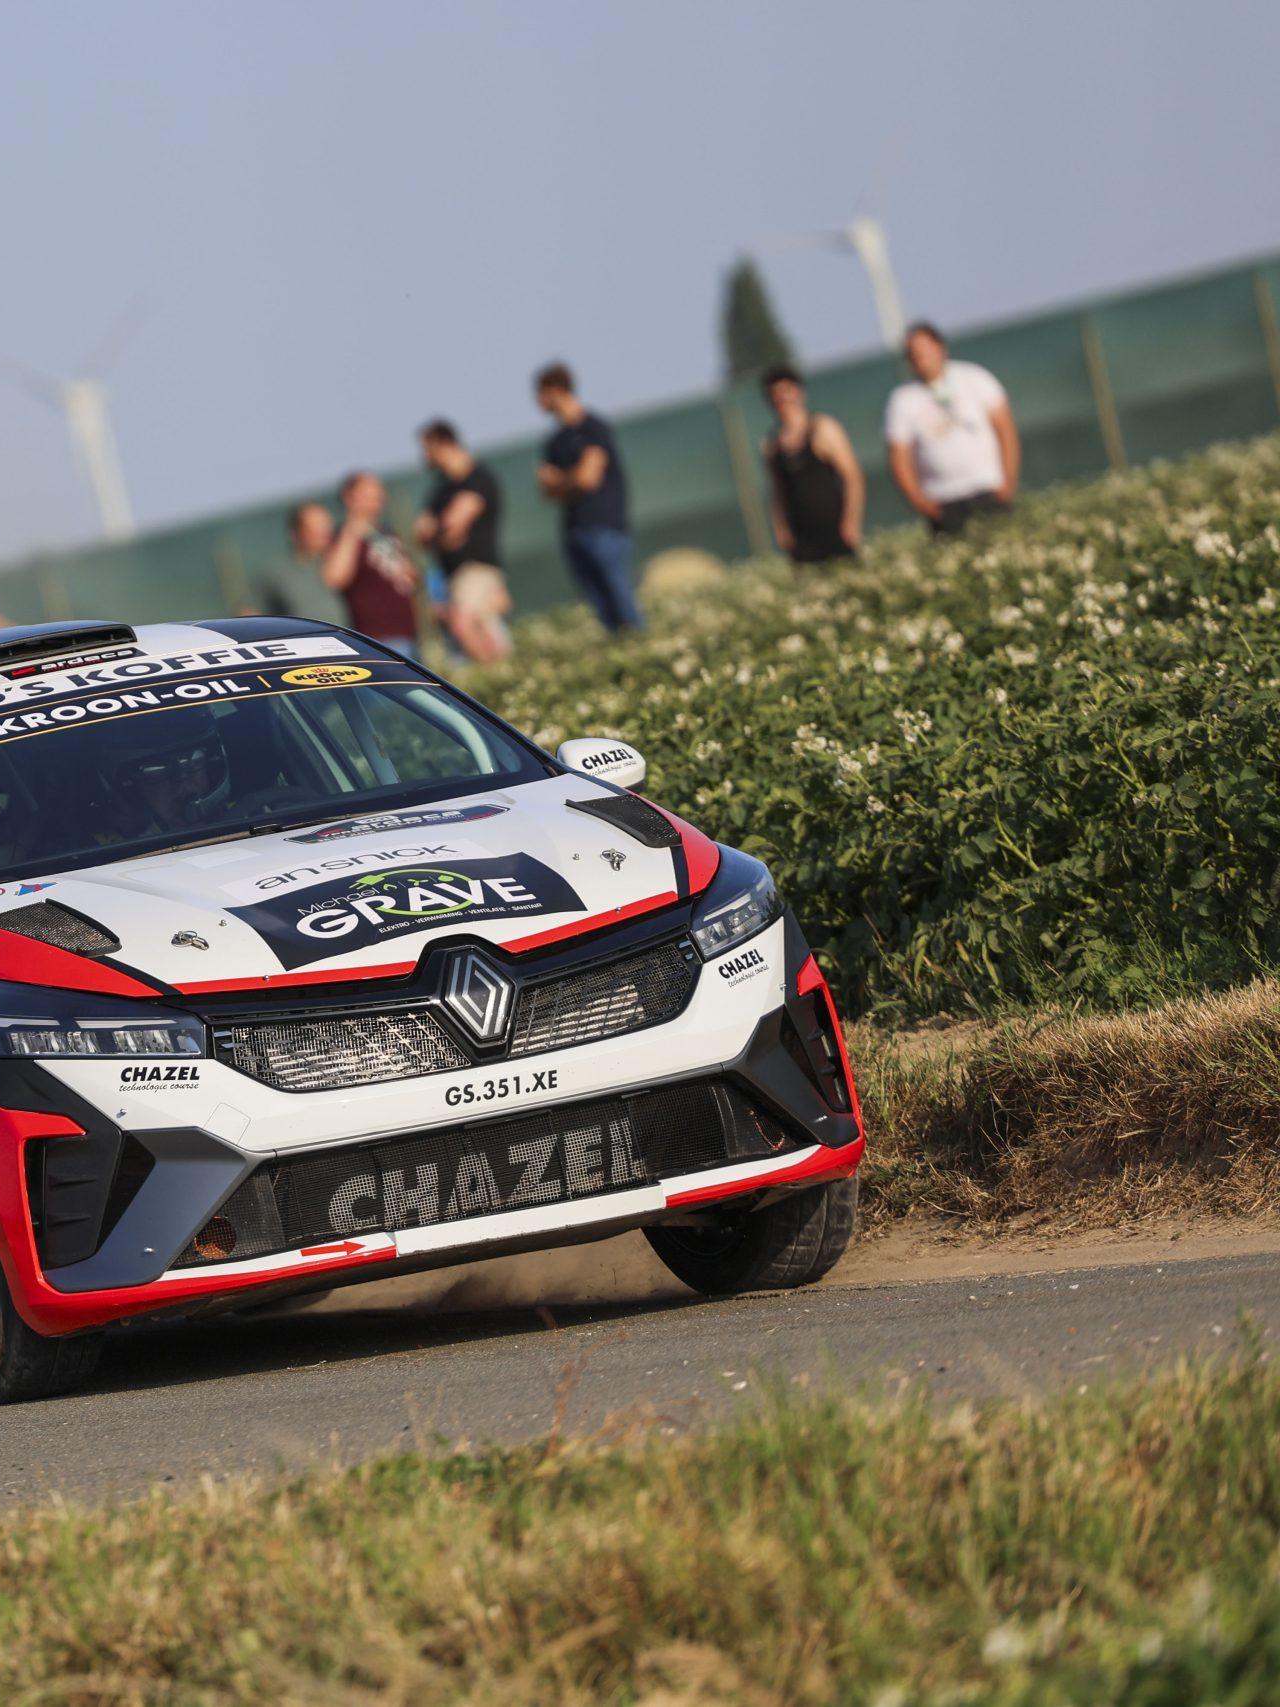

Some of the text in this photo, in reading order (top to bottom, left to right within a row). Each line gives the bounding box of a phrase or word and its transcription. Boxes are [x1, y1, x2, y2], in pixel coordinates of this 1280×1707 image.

[41, 650, 133, 671] ardeca
[66, 643, 296, 687] KOFFIE
[294, 669, 359, 681] KROON
[316, 676, 346, 684] OIL
[582, 748, 634, 769] CHAZEL
[296, 878, 536, 939] GRAVE
[297, 888, 380, 916] Michael
[378, 921, 410, 933] ELEKTRO
[415, 912, 463, 924] VERWARMING
[468, 906, 506, 915] VENTILATIE
[718, 949, 764, 979] CHAZEL
[119, 1083, 167, 1092] technologie
[120, 1067, 200, 1082] CHAZEL
[445, 1069, 558, 1106] GS.351.XE
[328, 1117, 648, 1235] CHAZEL
